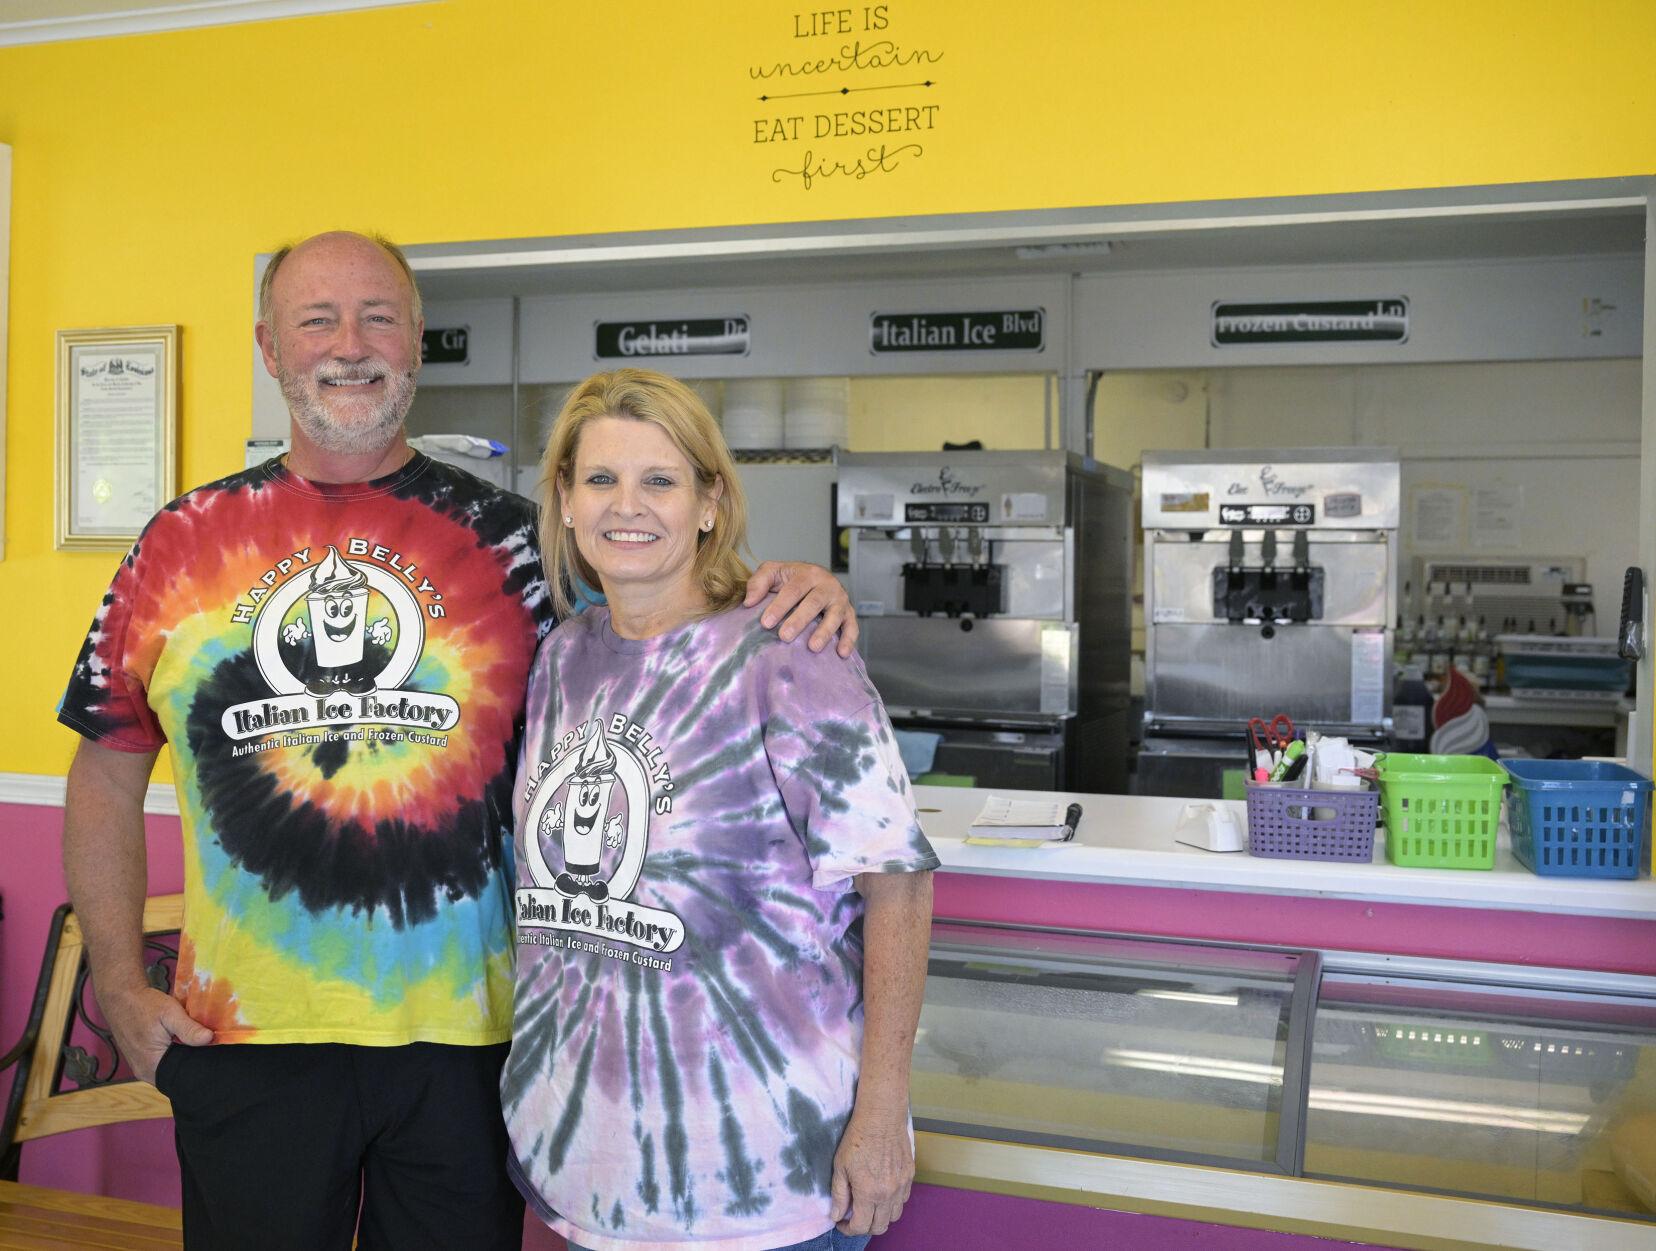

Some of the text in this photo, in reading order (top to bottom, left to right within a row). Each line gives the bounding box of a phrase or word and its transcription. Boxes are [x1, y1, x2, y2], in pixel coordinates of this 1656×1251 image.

[793, 5, 889, 38] LIFE IS
[749, 41, 944, 80] uncertain
[753, 105, 940, 143] EAT DESSERT
[772, 144, 923, 190] first
[441, 329, 466, 350] Cir
[618, 319, 747, 356] Gelati Dr
[881, 313, 1040, 347] Italian Ice Blvd
[1217, 315, 1287, 334] Frozen
[1292, 312, 1375, 332] Custard
[230, 538, 447, 624] HAPPY BELLY'S
[232, 696, 453, 735] Italian Ice Factory
[231, 728, 449, 758] Authentic Italian Ice and Frozen Custard
[525, 712, 675, 816] HAPPY BELLY'S
[517, 893, 678, 952] alian Ice Factory
[517, 932, 673, 972] entic Italian Ice and Frozen Custard
